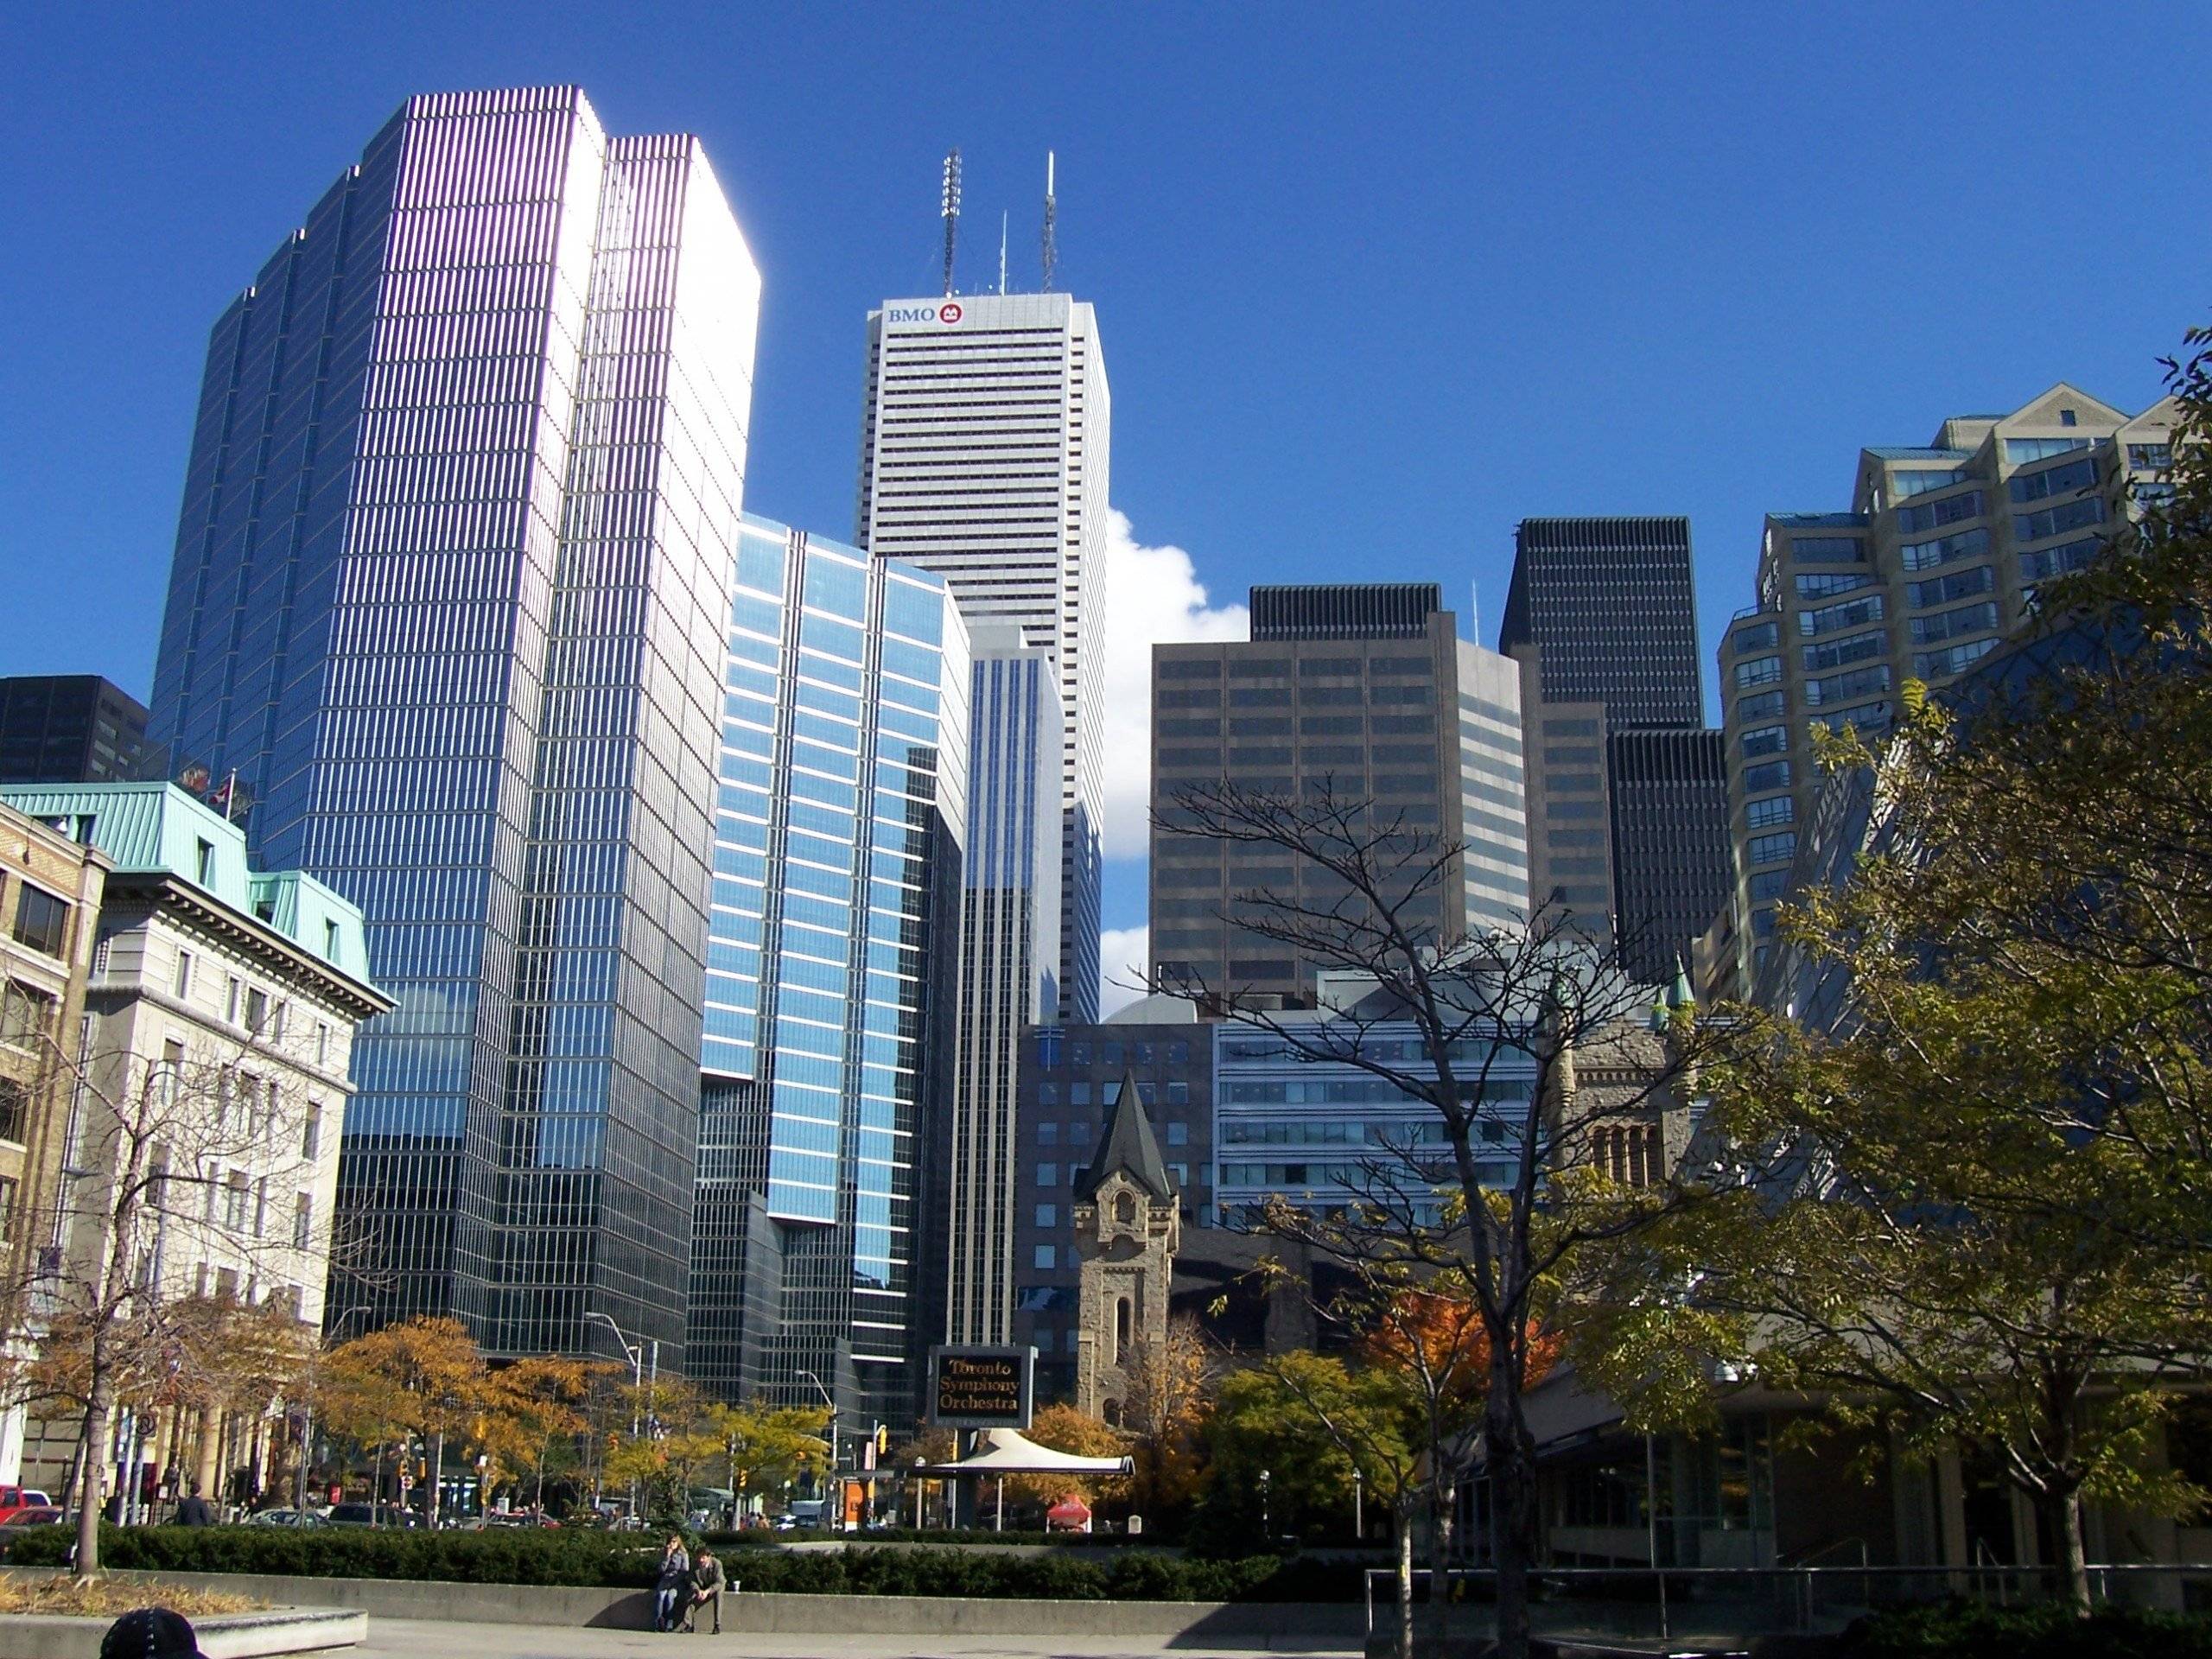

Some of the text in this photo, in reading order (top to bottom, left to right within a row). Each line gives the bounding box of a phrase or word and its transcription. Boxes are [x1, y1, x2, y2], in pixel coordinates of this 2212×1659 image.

[888, 308, 935, 322] BMO
[949, 1359, 1011, 1375] Toronto
[940, 1376, 1019, 1395] Symphony
[940, 1394, 1017, 1409] Orchestra
